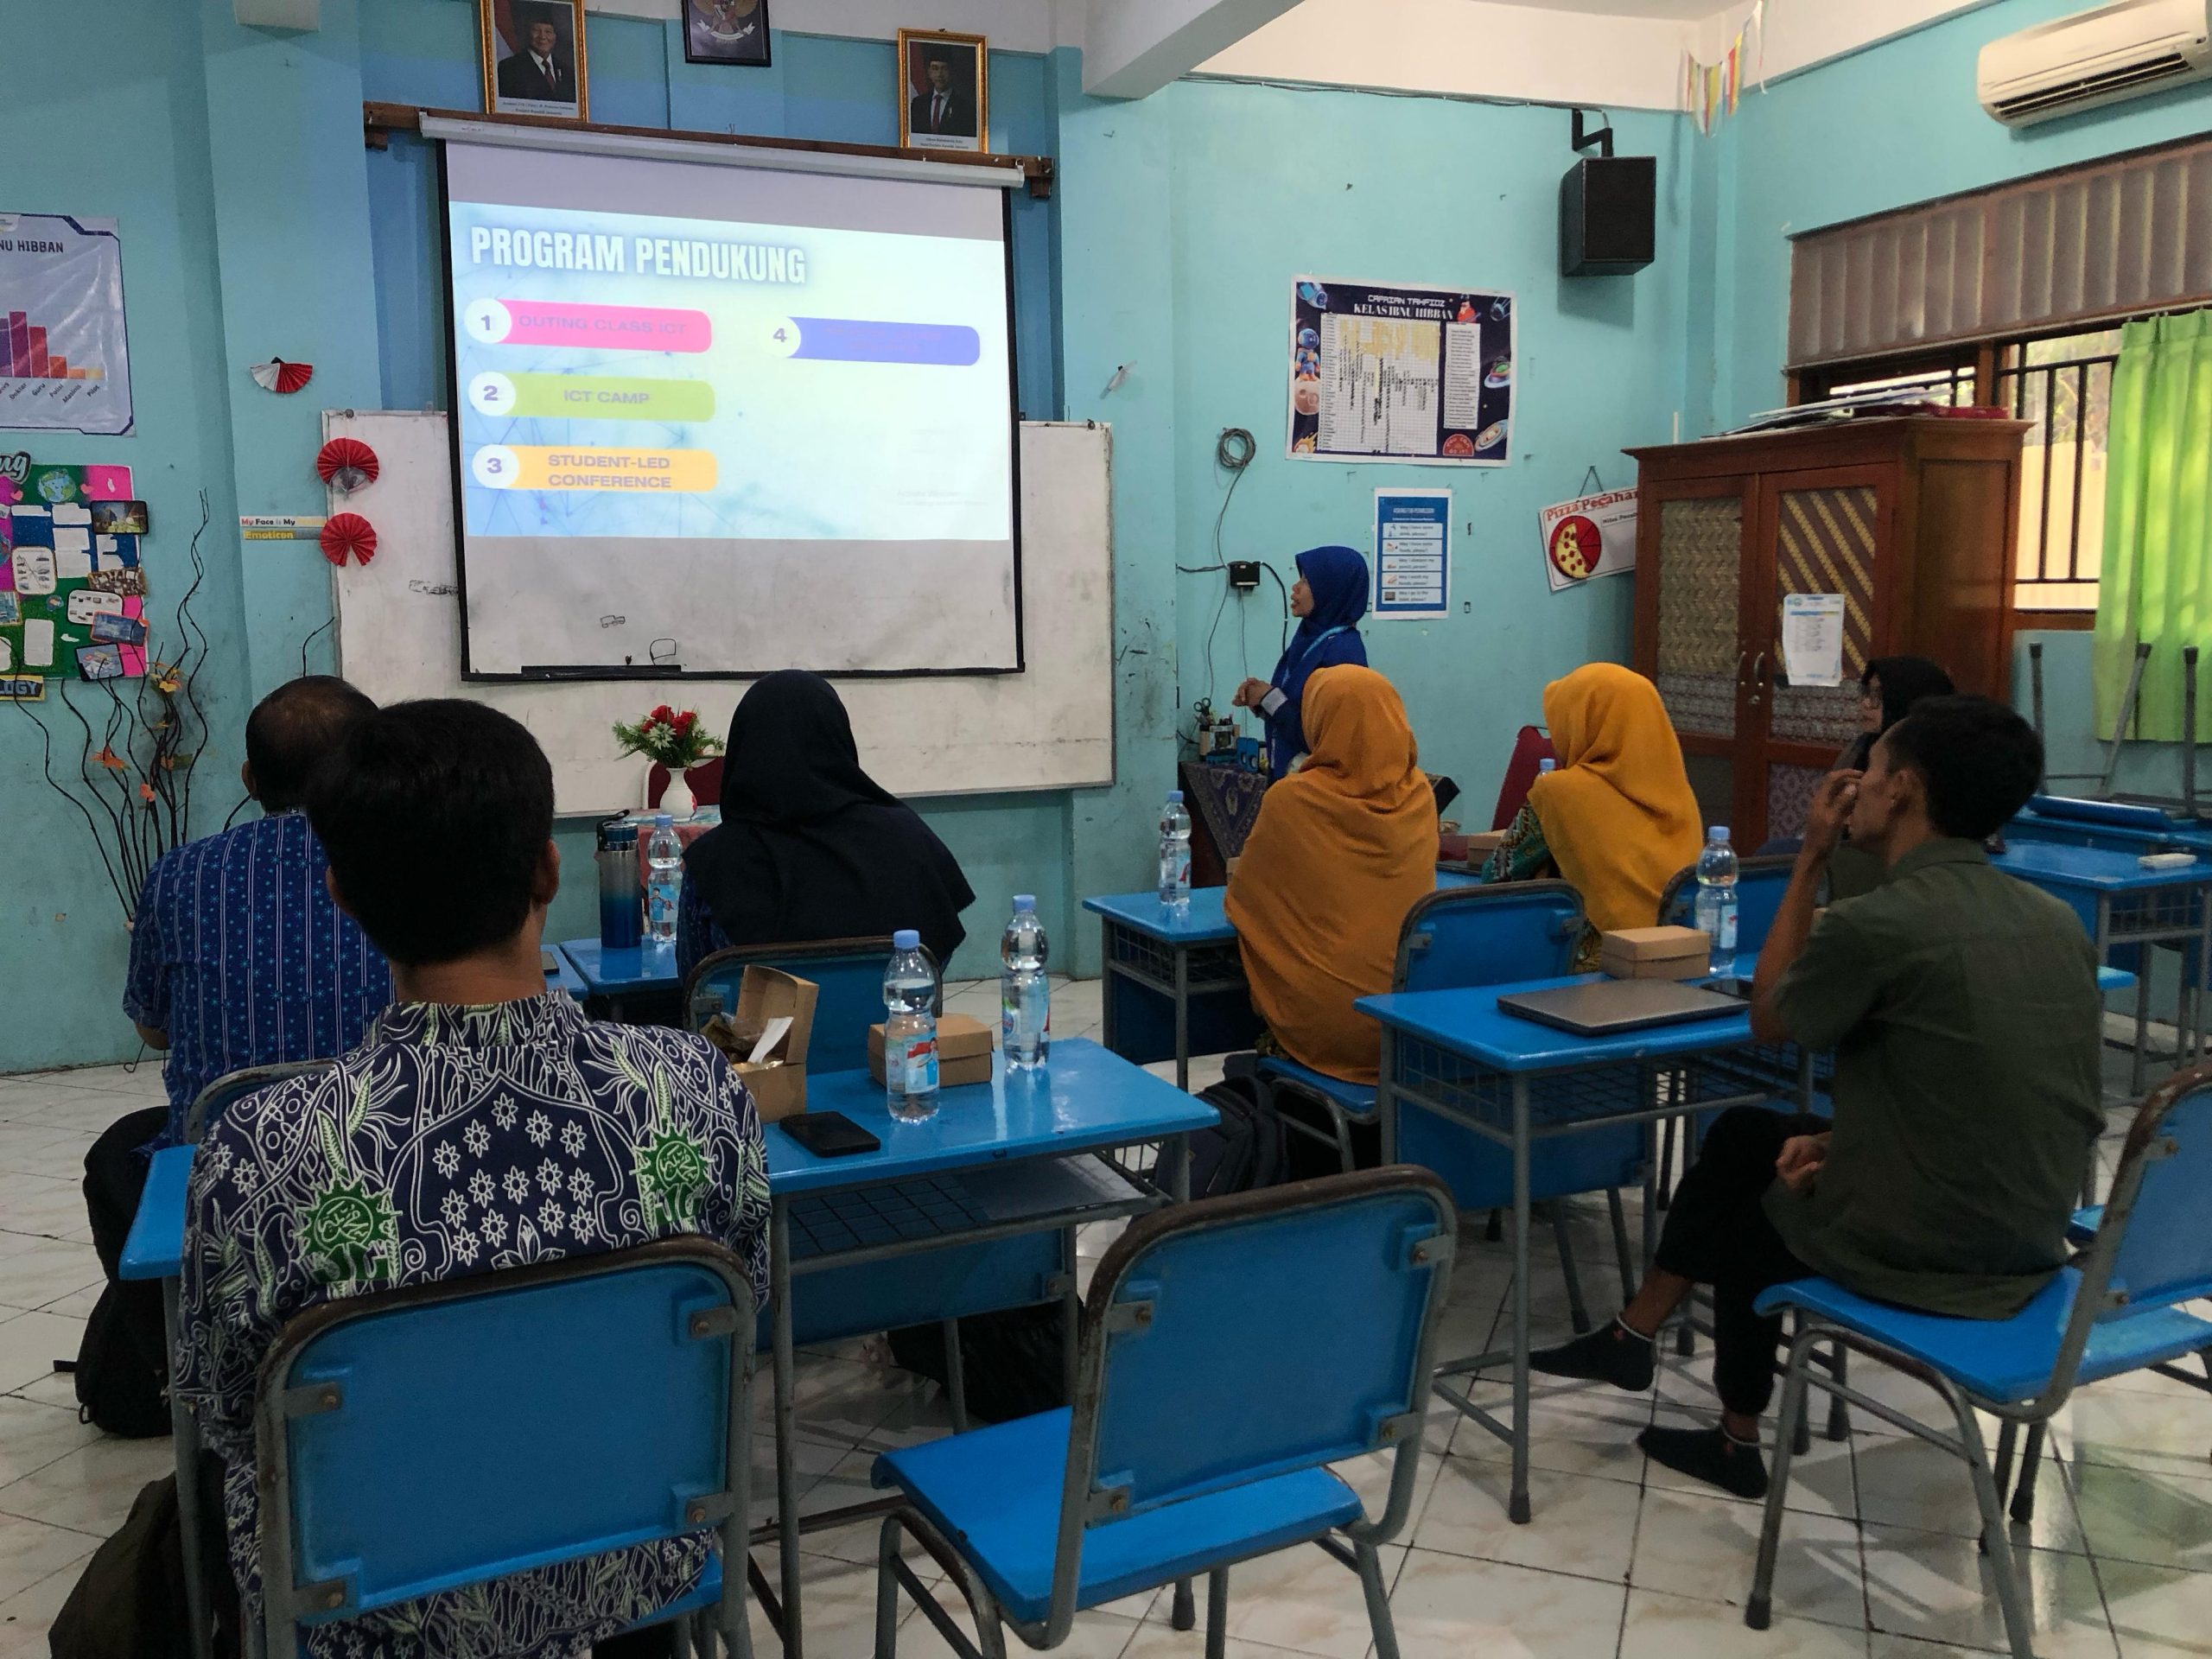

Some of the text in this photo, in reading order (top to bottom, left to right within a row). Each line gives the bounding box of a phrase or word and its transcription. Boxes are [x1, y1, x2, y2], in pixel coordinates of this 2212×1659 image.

[18, 240, 63, 253] HIBBAN
[471, 226, 805, 283] PROGRAM PENDUKUNG
[1354, 303, 1388, 315] KELAS
[1389, 306, 1414, 317] IBNU
[480, 315, 491, 331] 1
[519, 315, 686, 335] OUTING CLASS ICT
[772, 327, 787, 343] 4
[31, 383, 46, 397] Guru
[483, 385, 498, 401] 2
[563, 390, 649, 404] ICT CAMP
[486, 458, 502, 474] 3
[548, 454, 670, 469] STUDENT-LED
[548, 474, 671, 488] CONFERENCE
[1547, 503, 1580, 521] Pizza
